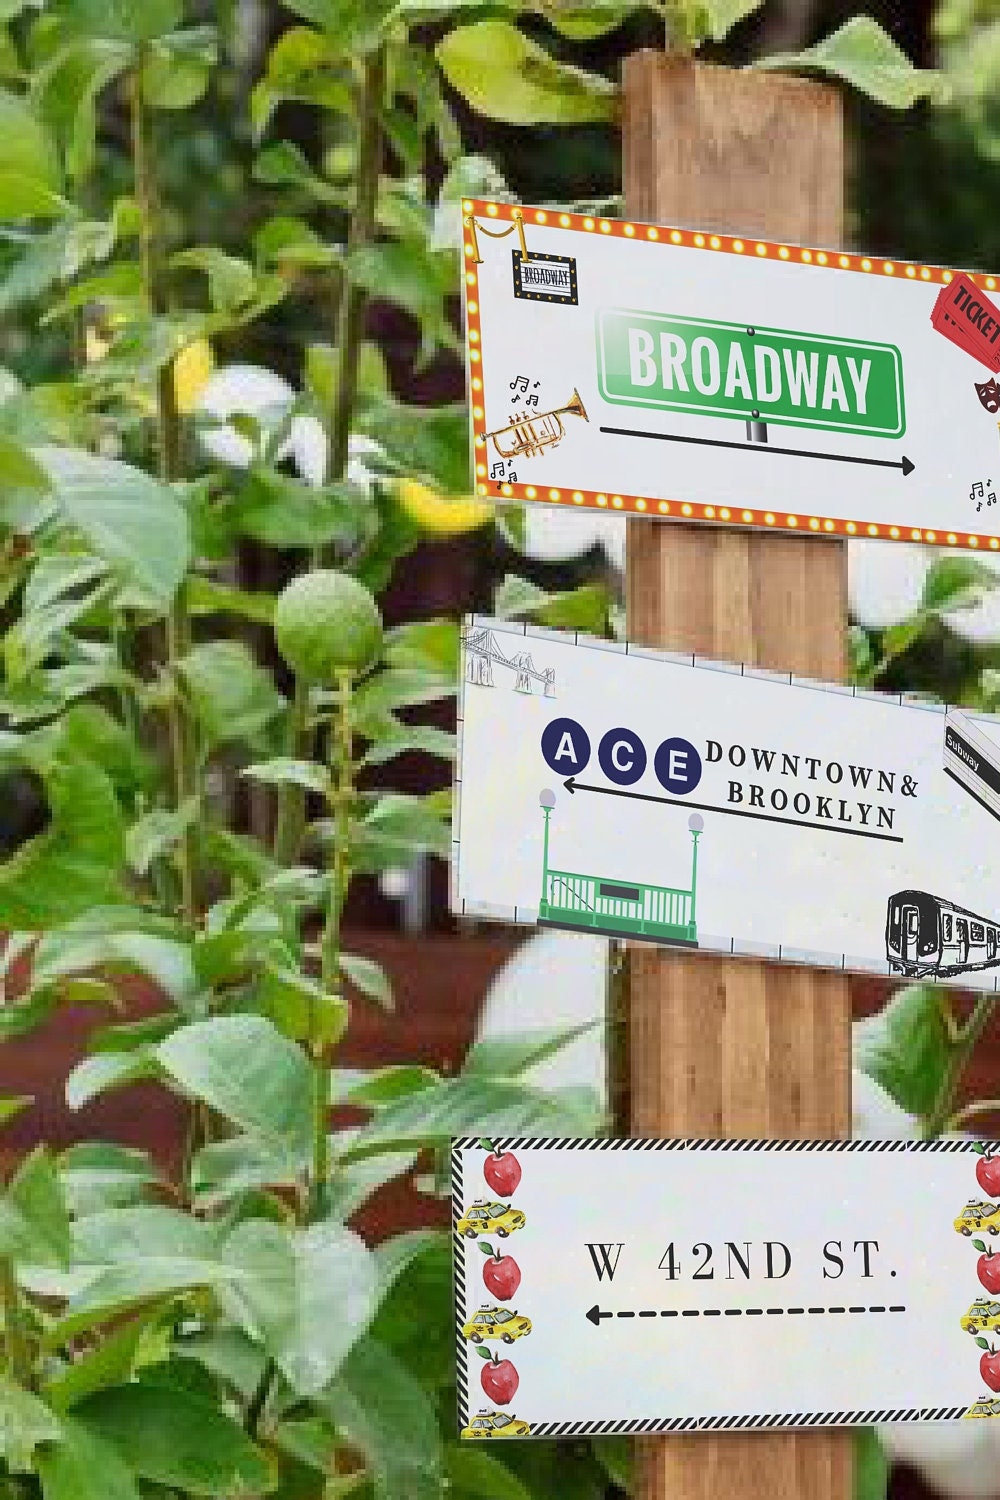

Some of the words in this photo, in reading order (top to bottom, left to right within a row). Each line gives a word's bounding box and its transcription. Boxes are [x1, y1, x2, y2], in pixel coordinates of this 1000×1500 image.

[524, 266, 568, 286] BROADWAY
[628, 328, 871, 415] BROADWAY
[554, 730, 578, 765] A
[611, 739, 636, 773] C
[669, 749, 688, 783] E
[705, 739, 919, 798] DOWNTOWN&
[947, 734, 980, 772] Subway
[727, 781, 896, 829] BROOKLYN
[585, 1242, 626, 1282] W
[657, 1241, 793, 1281] 42ND
[822, 1239, 899, 1279] ST.
